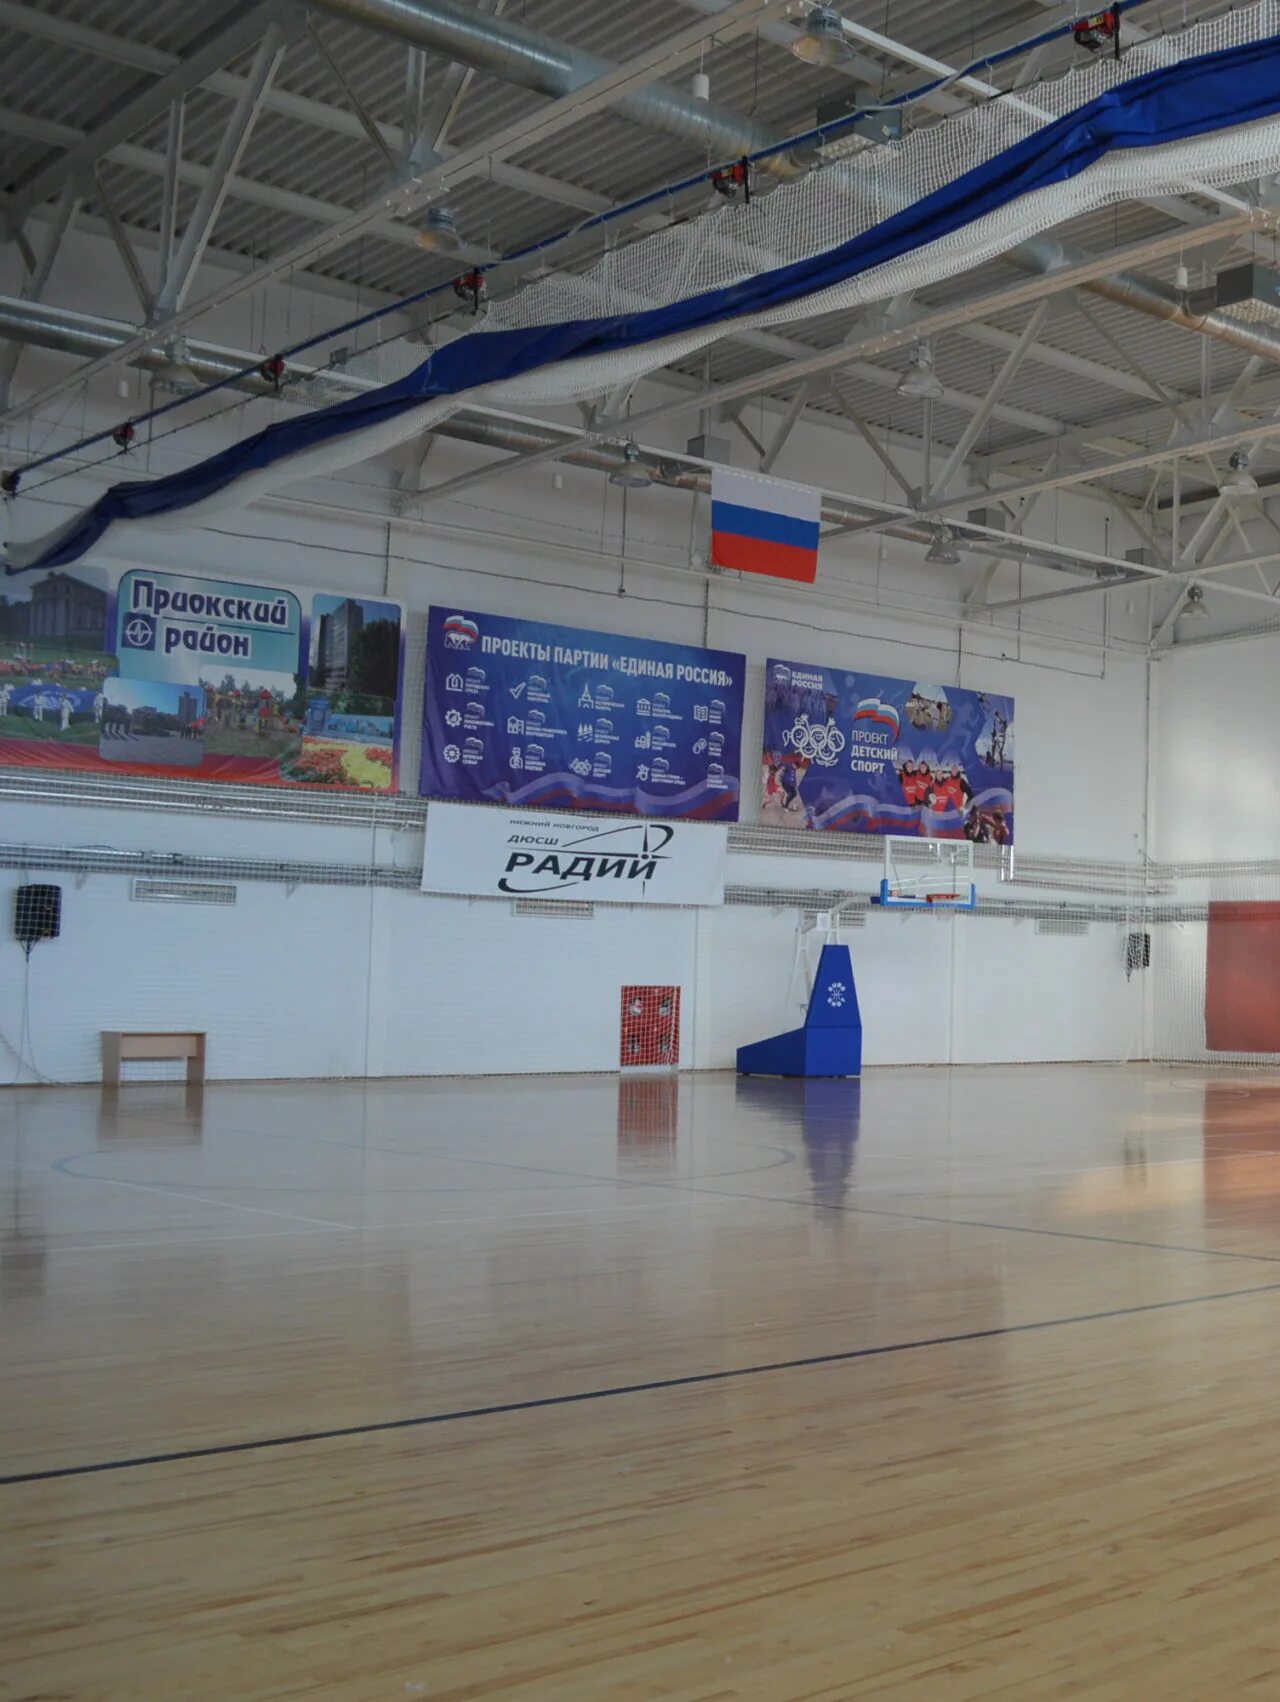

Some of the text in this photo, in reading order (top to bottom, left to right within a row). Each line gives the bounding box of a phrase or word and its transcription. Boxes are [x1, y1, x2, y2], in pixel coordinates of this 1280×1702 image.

[131, 578, 288, 626] Приокский
[164, 625, 250, 656] район
[481, 635, 733, 687] ПРОЕКТЫ ПАРТИИ «ЕДИНАЯ РОССИЯ»
[791, 680, 823, 690] РОССИЯ
[852, 730, 889, 746] ПРОЕКТ
[851, 744, 899, 761] ДЕТСКИЙ
[850, 760, 885, 774] СПОРТ
[507, 834, 559, 846] ДЮСШ
